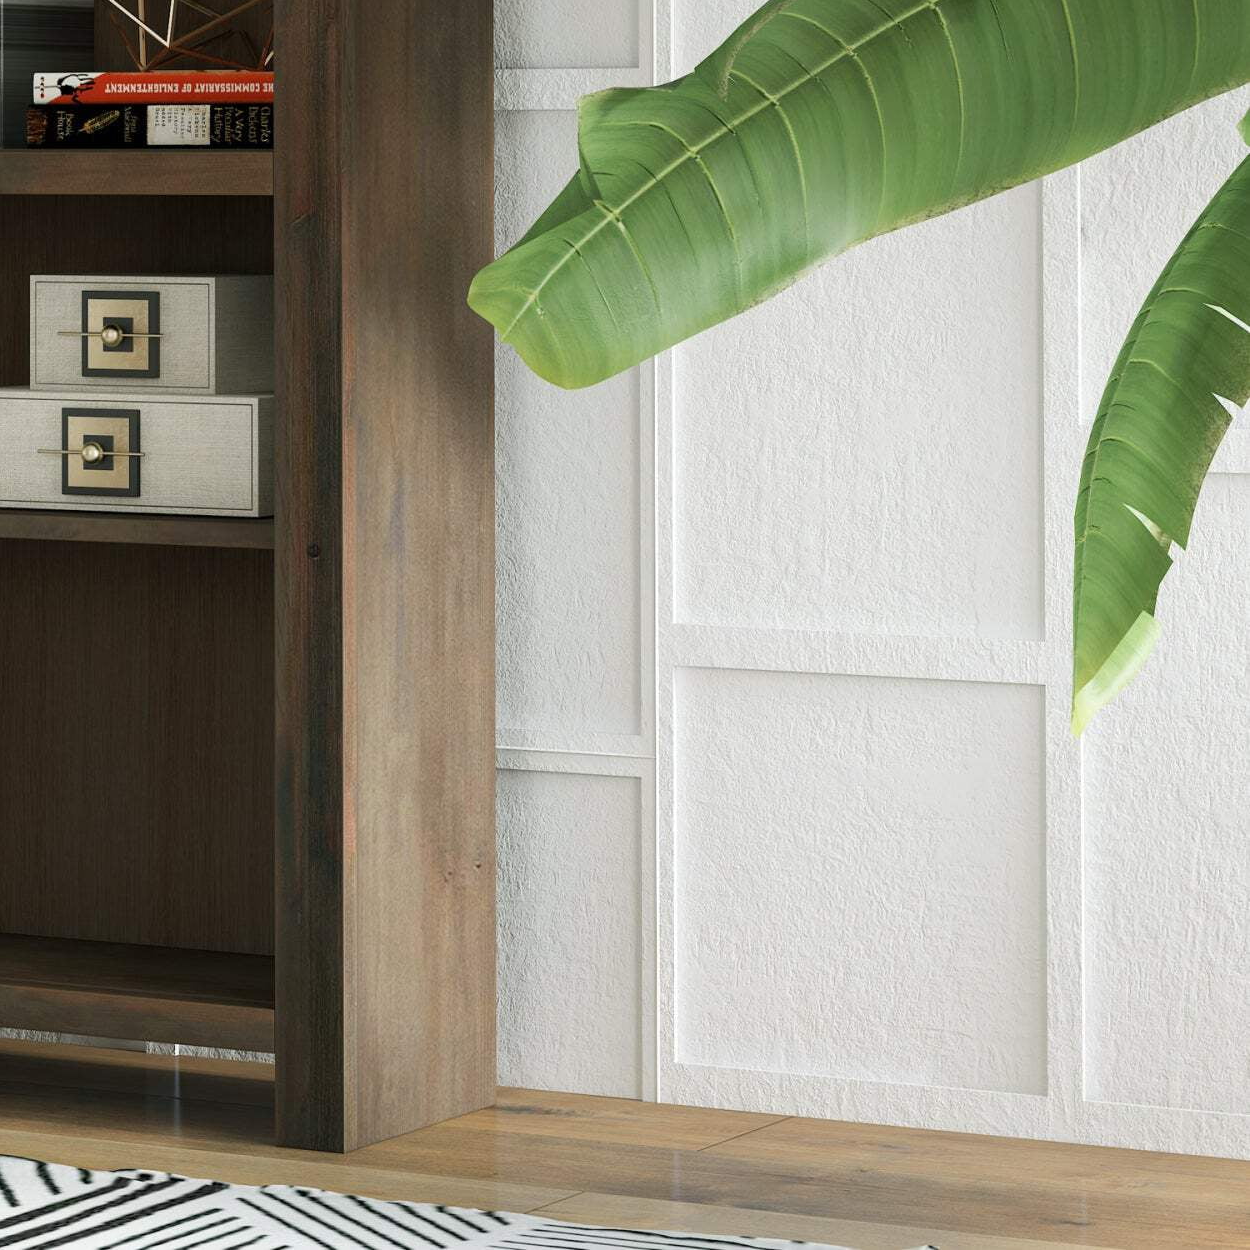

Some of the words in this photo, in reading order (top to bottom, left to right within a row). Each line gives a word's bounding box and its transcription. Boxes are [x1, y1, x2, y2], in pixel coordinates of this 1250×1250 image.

[104, 83, 179, 94] ENLIGHTENMENT
[181, 83, 192, 93] OF
[194, 82, 261, 93] COMMISSARIAT
[262, 82, 274, 93] HE
